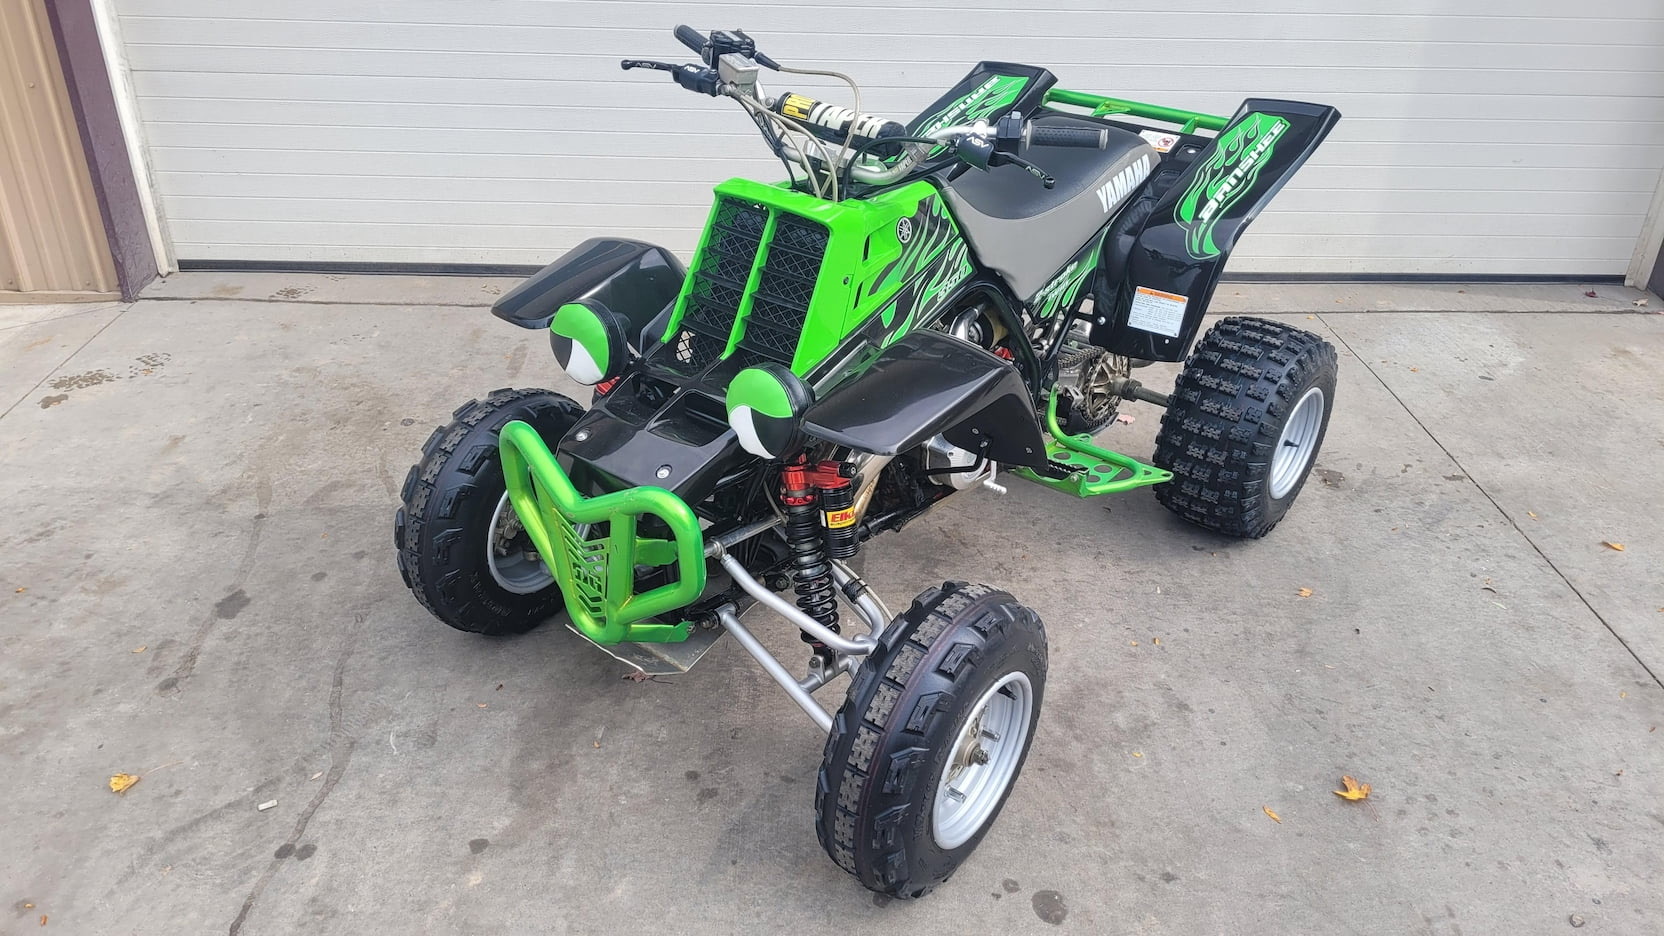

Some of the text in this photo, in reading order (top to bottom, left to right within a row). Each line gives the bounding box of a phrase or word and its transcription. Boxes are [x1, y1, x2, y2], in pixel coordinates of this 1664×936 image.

[684, 65, 700, 74] ASV
[966, 136, 990, 149] ASV
[1025, 165, 1046, 180] ASV
[1198, 119, 1286, 223] BANSHEE
[1096, 153, 1151, 214] YAMAHA
